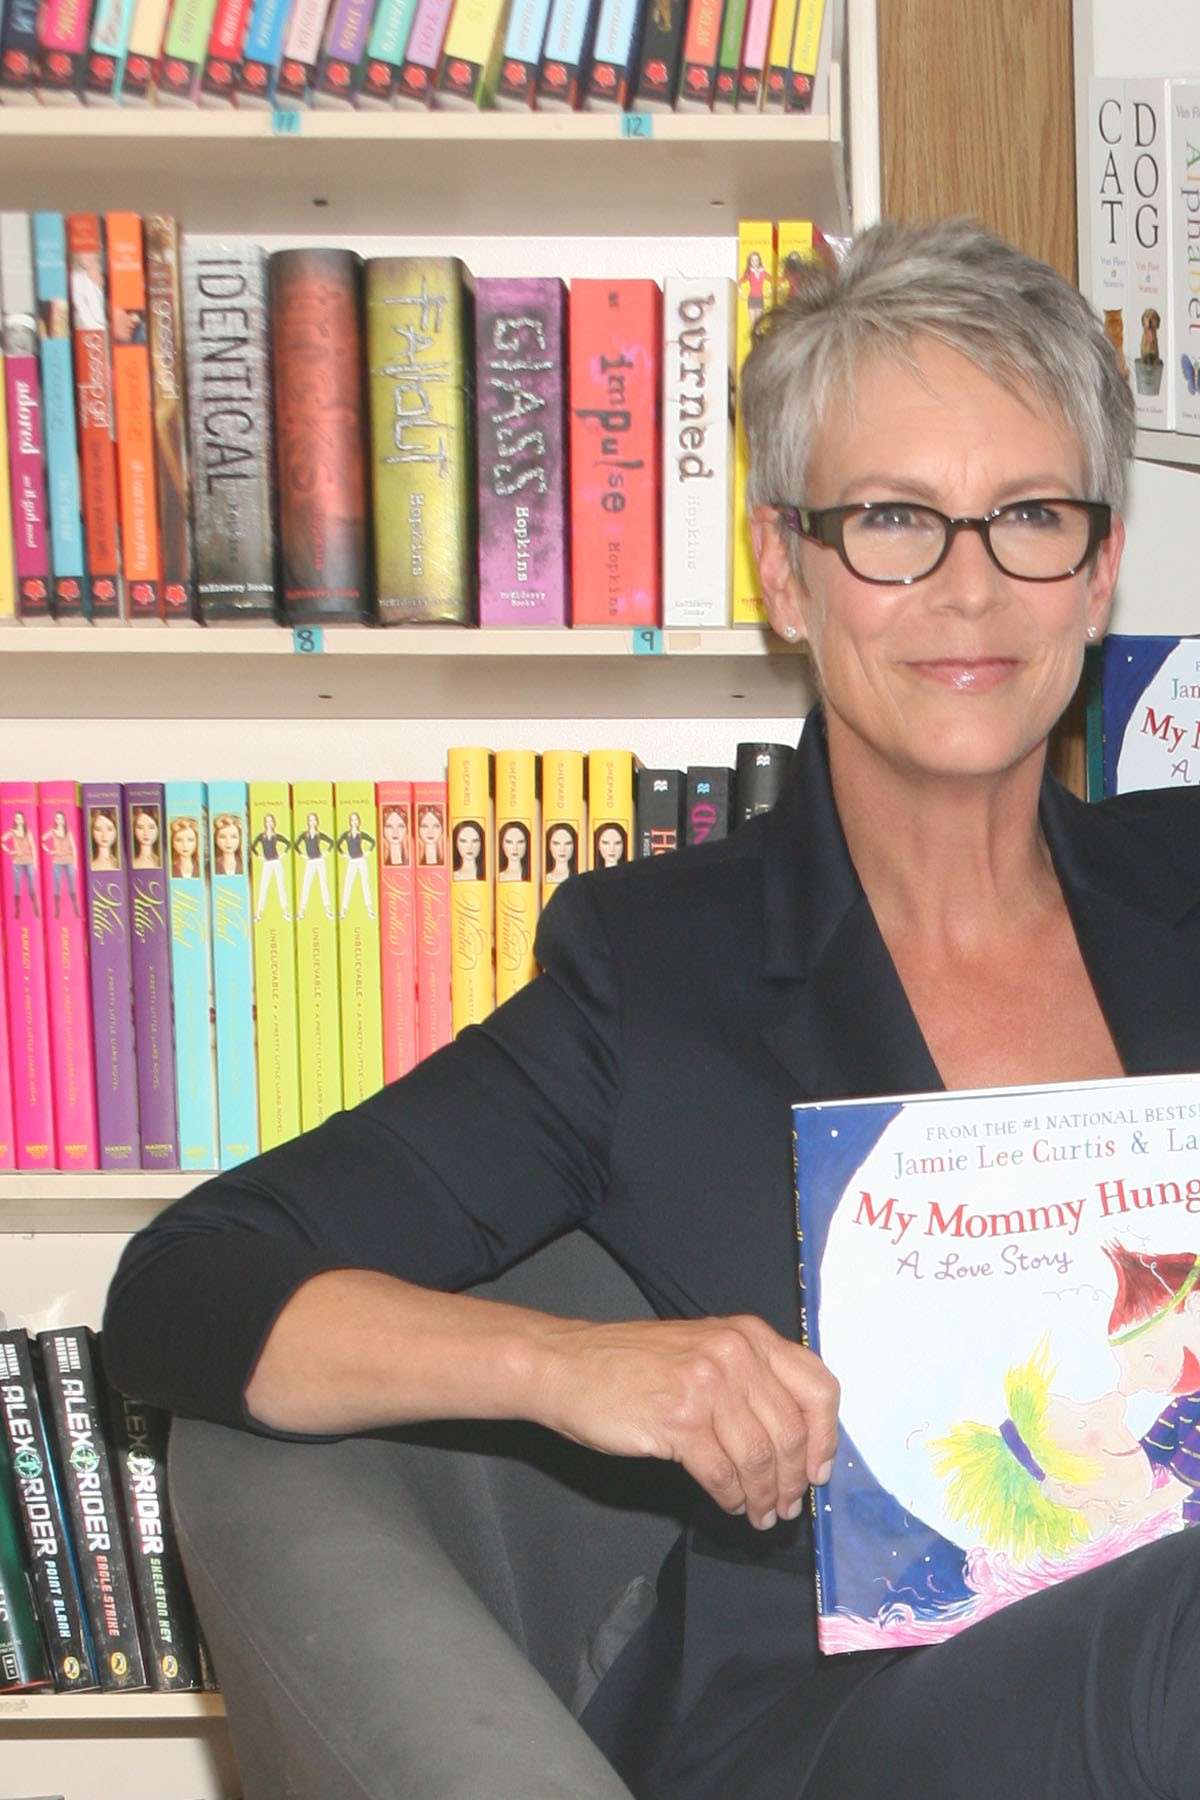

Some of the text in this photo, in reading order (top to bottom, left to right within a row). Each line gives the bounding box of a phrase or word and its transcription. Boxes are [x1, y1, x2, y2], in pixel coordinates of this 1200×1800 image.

[627, 117, 645, 136] 12
[1098, 99, 1124, 244] CAT
[1133, 102, 1160, 249] DOG
[197, 259, 256, 495] IDENTICAL
[679, 292, 715, 483] burned
[515, 507, 529, 583] Hopkins
[297, 629, 314, 653] 8
[1140, 707, 1187, 753] My
[1171, 759, 1191, 784] A
[270, 929, 279, 1001] UNBELIEVABLE
[893, 1148, 968, 1179] Jamie
[977, 1143, 1024, 1169] Lee
[1033, 1135, 1116, 1163] Curtis
[1131, 1131, 1150, 1155] &
[927, 1125, 977, 1141] FROM
[984, 1121, 1017, 1137] THE
[1023, 1119, 1041, 1133] #1
[1046, 1109, 1141, 1132] NATIONAL
[851, 1190, 918, 1246] My
[923, 1195, 1088, 1238] Mommy
[896, 1245, 1074, 1281] A Love Story
[1, 1385, 56, 1556] ALEX RIDER
[61, 1379, 110, 1552] ALEX RIDER
[131, 1474, 163, 1555] RIDER
[45, 1560, 71, 1638] POINT BLANK
[151, 1557, 172, 1642] SKELETON KEY
